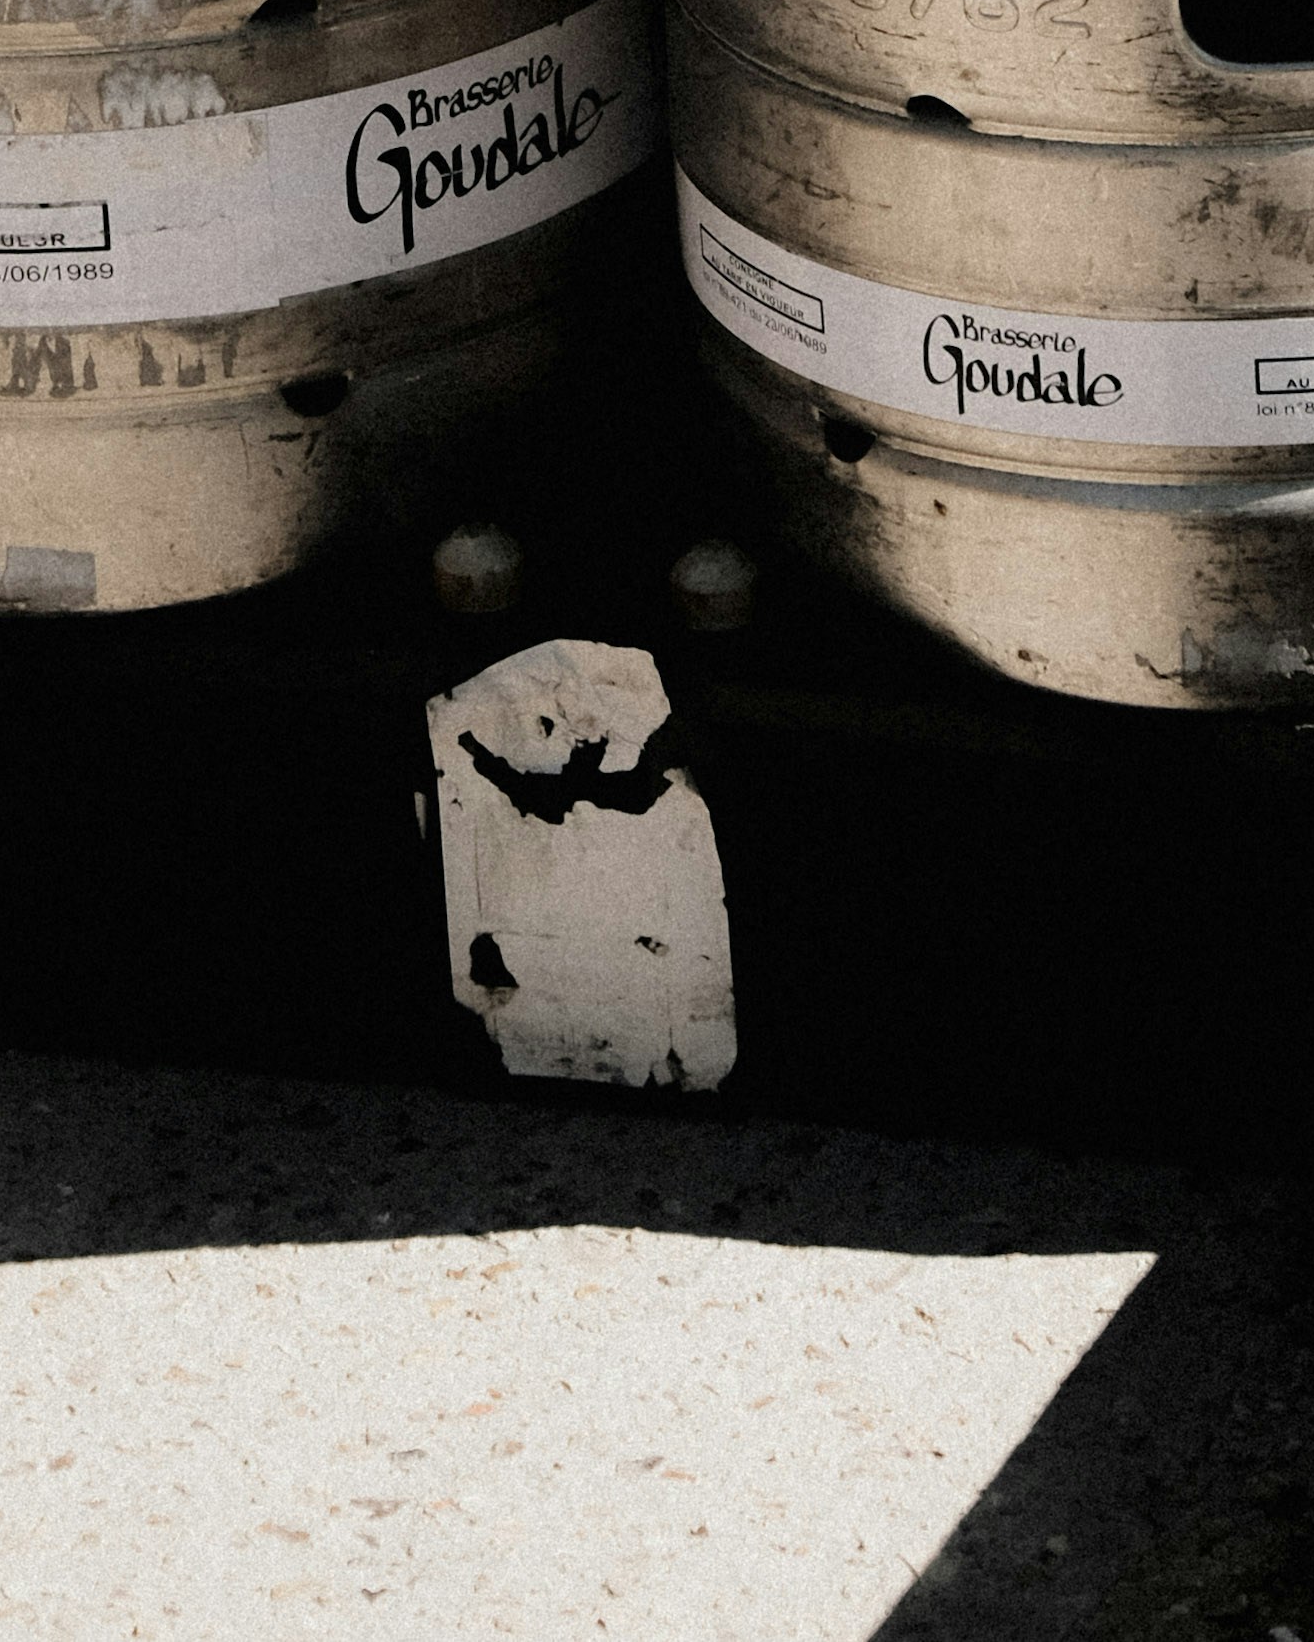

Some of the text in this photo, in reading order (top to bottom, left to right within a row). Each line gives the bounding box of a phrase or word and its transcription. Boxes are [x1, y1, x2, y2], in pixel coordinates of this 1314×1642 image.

[407, 54, 554, 131] Brasserie
[346, 63, 608, 255] Goudale
[760, 288, 805, 320] VIGUEUR
[961, 314, 1077, 353] Brasserie
[923, 314, 1124, 415] Goudale
[1286, 378, 1310, 389] AU
[1257, 402, 1278, 416] loi
